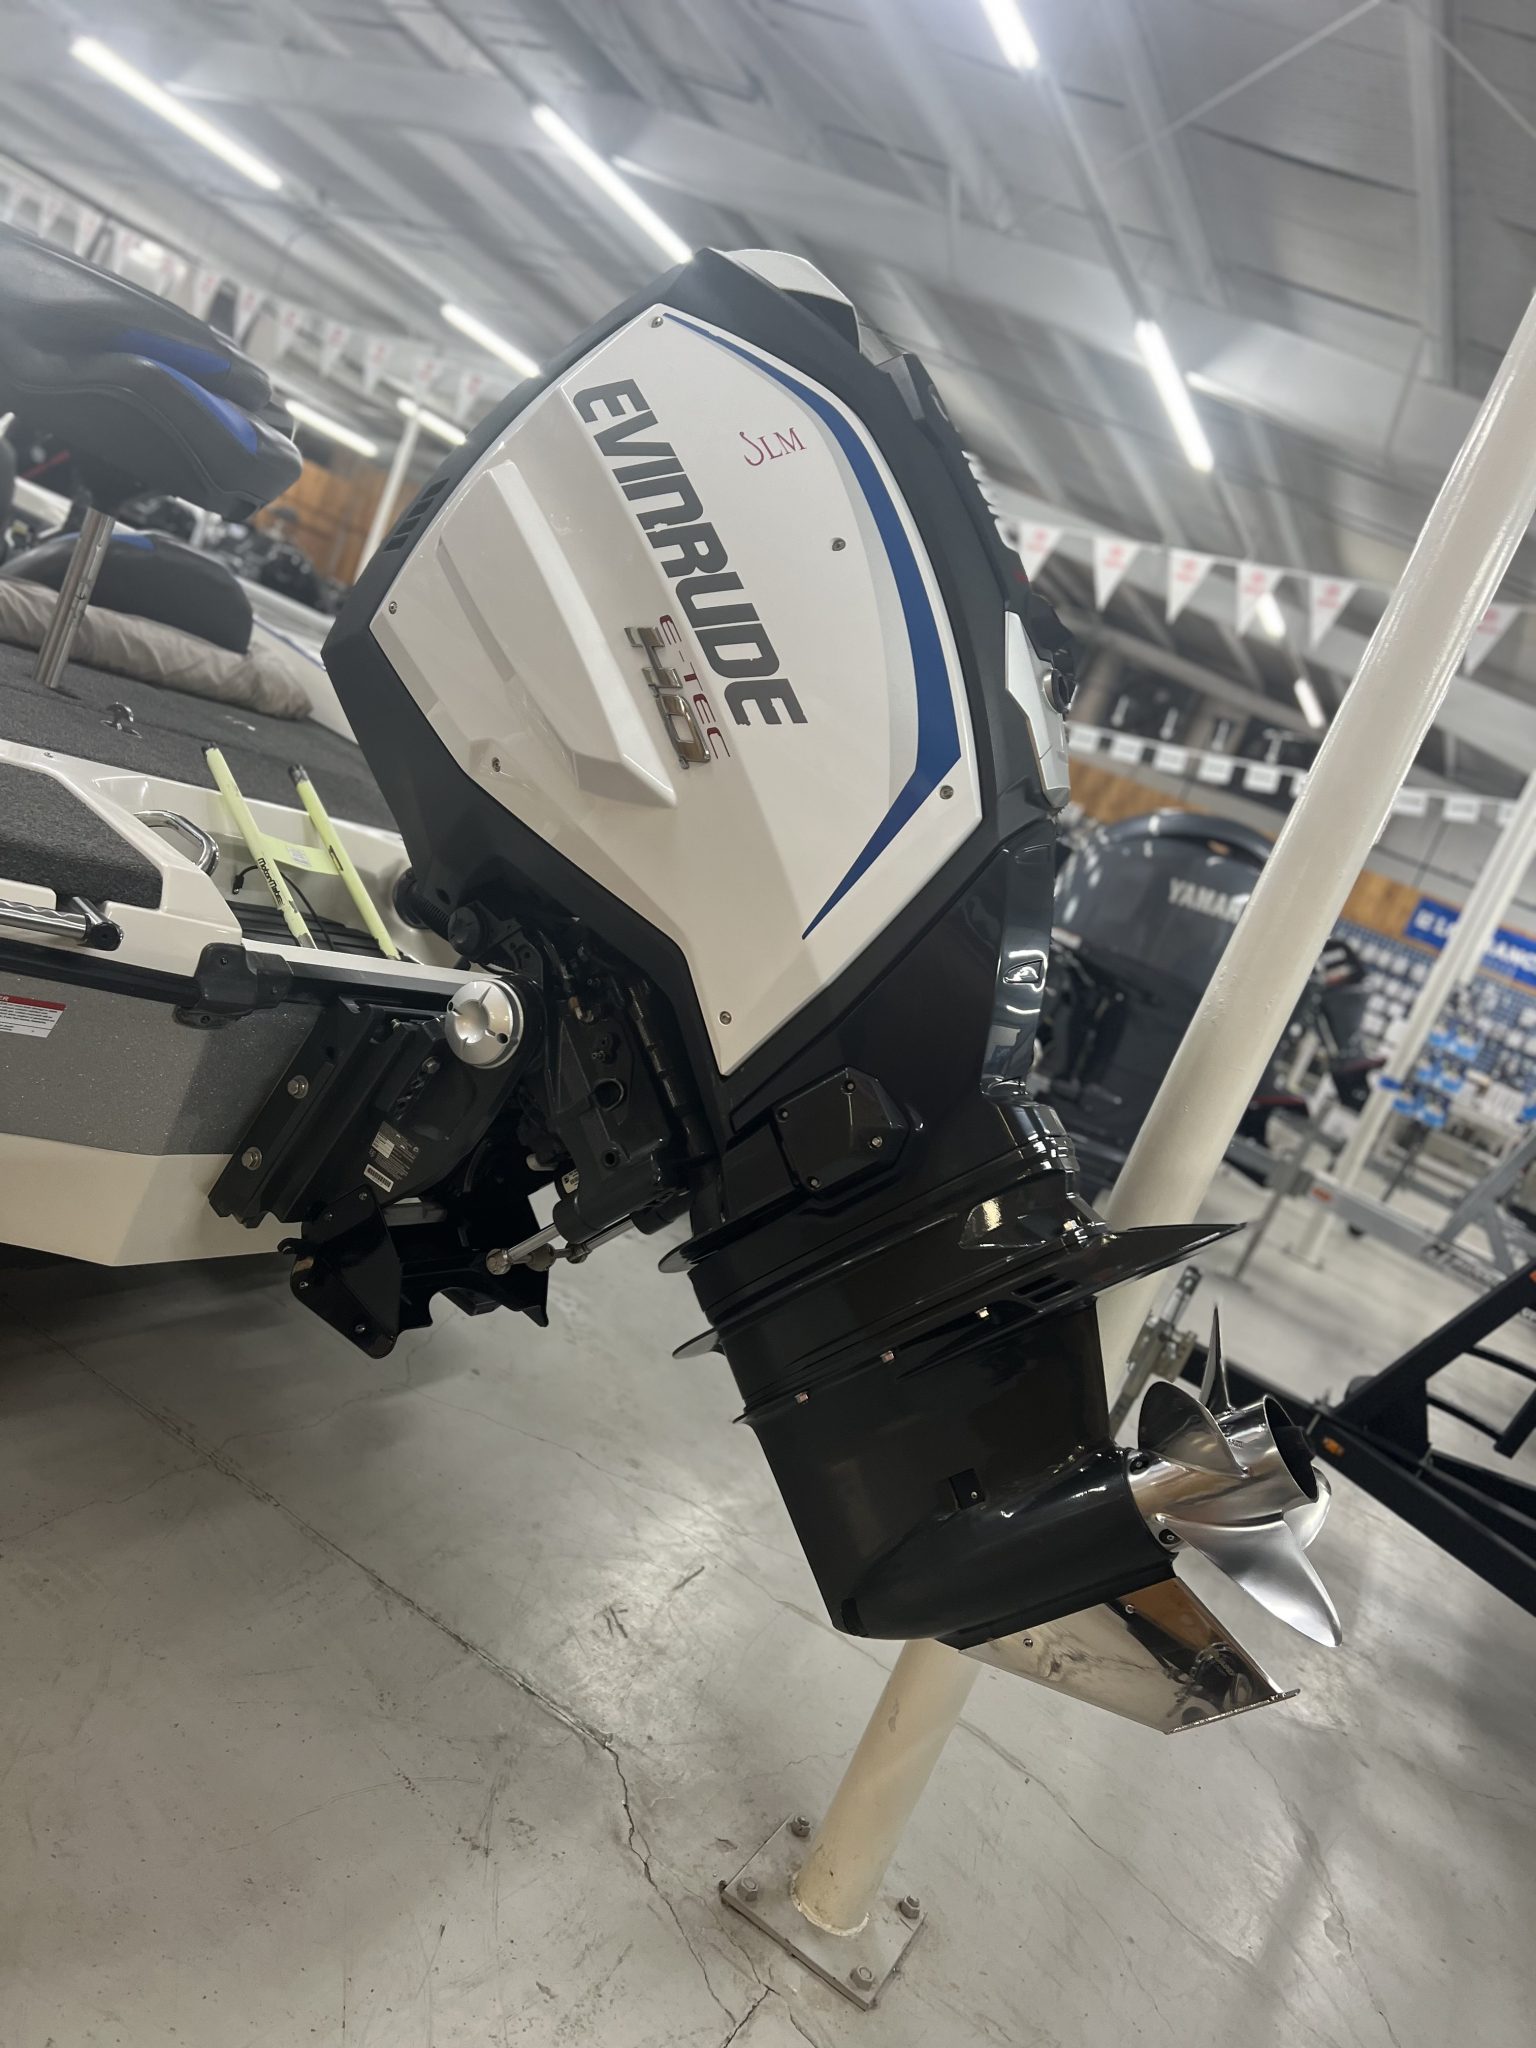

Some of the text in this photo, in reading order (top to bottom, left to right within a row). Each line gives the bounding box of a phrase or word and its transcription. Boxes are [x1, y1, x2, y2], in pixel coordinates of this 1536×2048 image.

[573, 379, 808, 726] EVINRUDE
[660, 615, 730, 759] E-TEC
[1169, 878, 1249, 923] YAMAH
